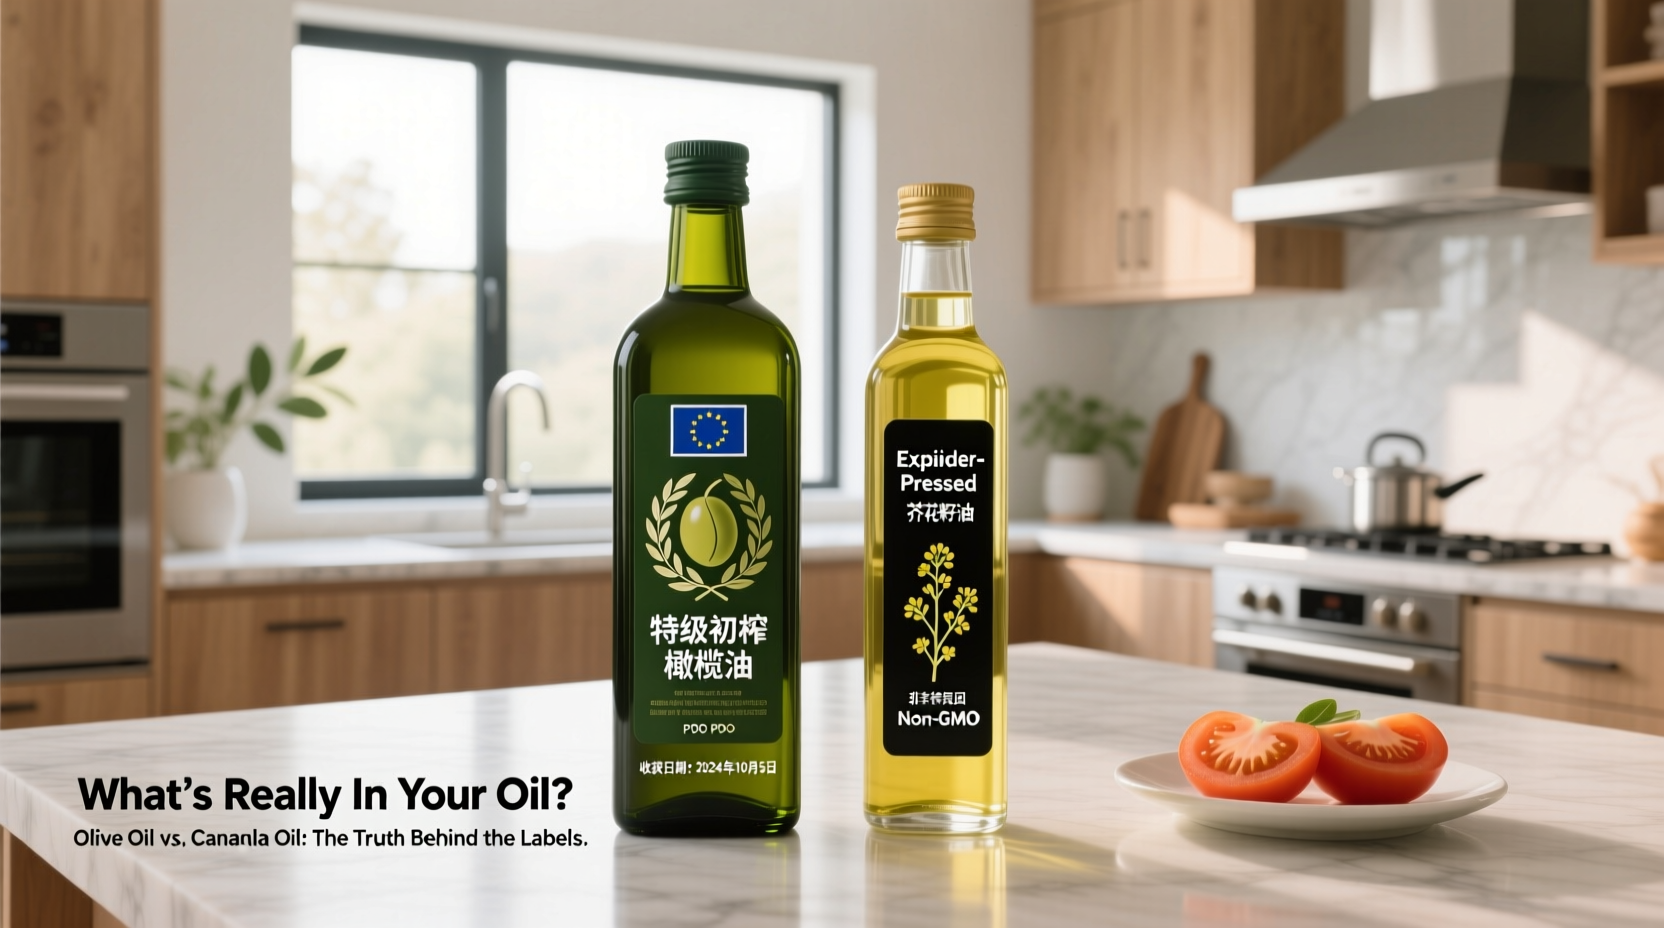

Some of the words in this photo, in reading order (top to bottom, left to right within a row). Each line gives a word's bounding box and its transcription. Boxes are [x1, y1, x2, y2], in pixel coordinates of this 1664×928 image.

[901, 473, 976, 493] Pressed
[649, 613, 768, 645] 特级初榨
[663, 648, 753, 680] 橄榄油
[897, 710, 981, 727] Non-GMO
[683, 723, 708, 735] PDO
[711, 723, 736, 735] PDO
